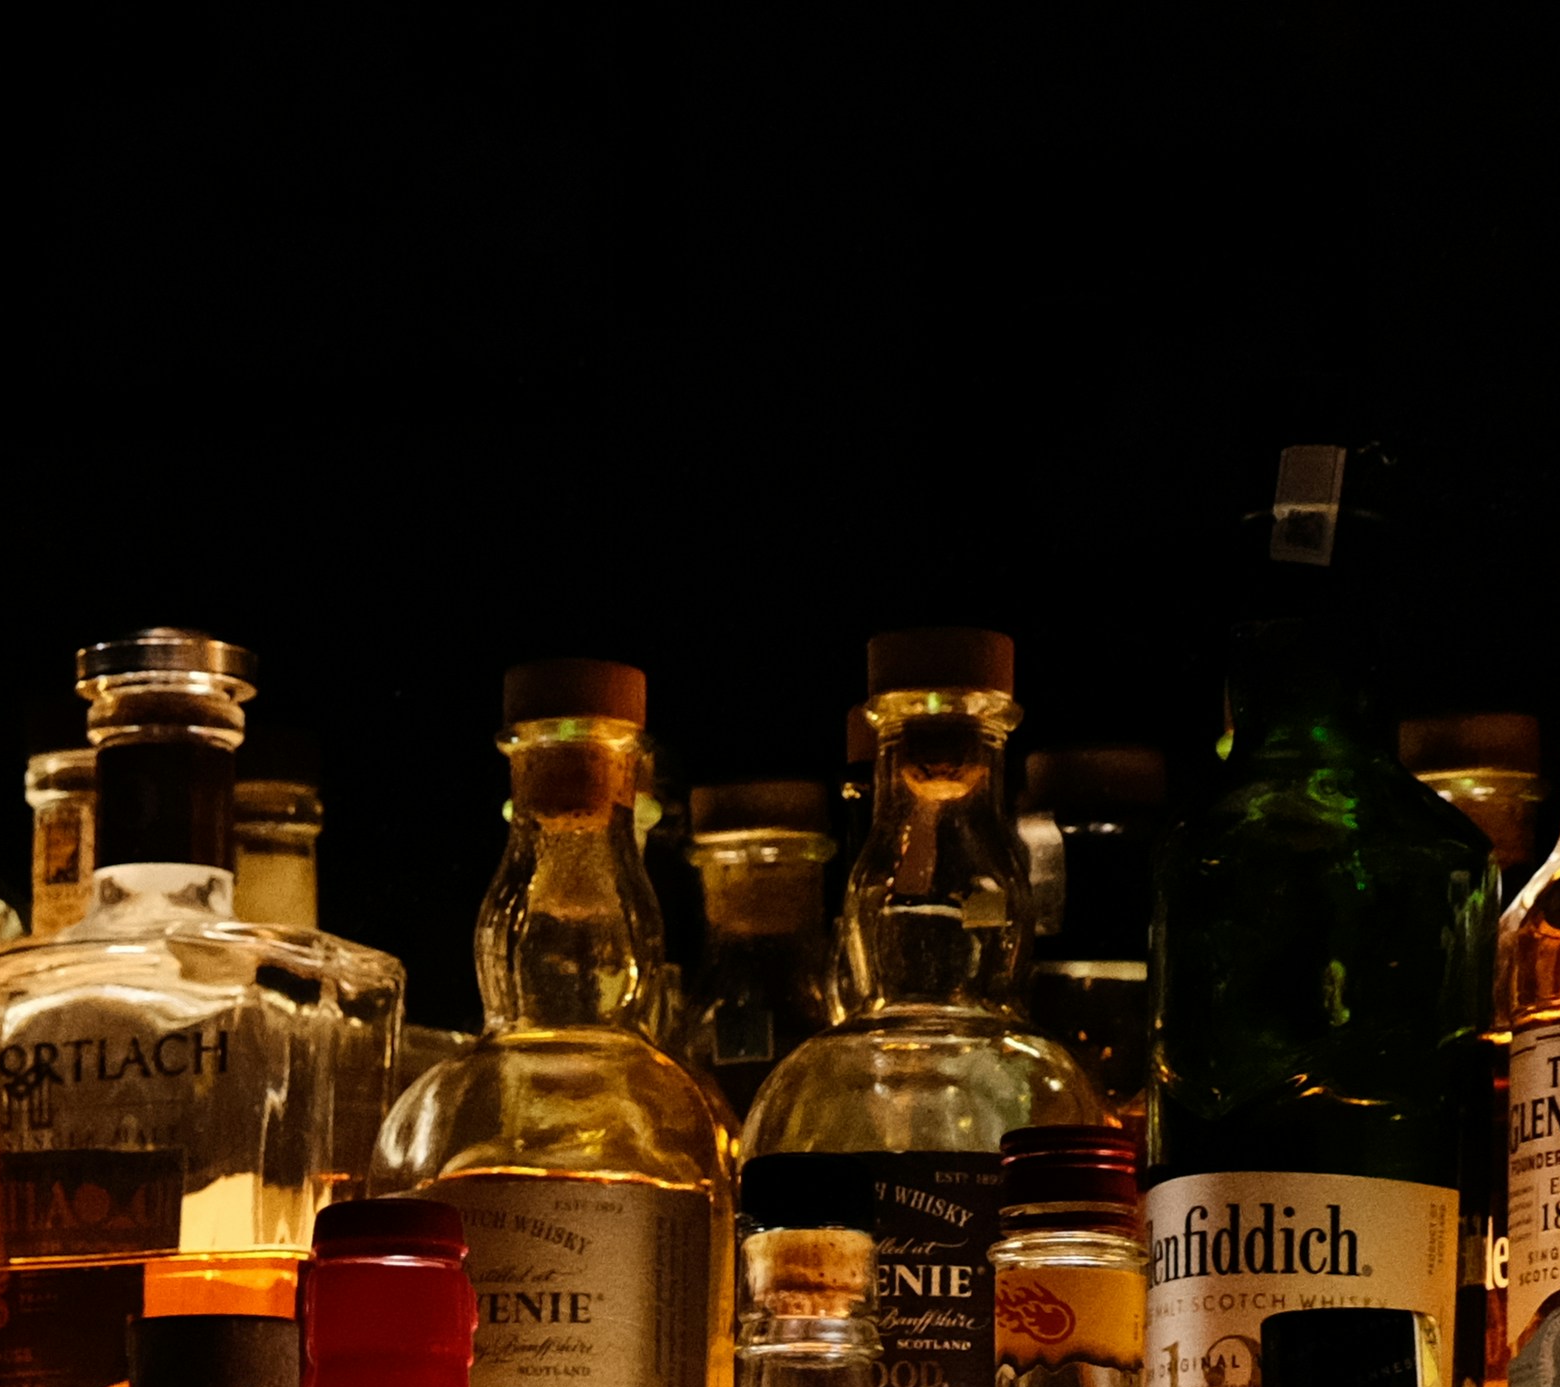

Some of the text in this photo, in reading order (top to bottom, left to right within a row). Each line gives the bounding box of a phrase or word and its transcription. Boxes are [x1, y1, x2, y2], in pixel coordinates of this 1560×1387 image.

[895, 1185, 974, 1227] WHISKY
[515, 1214, 592, 1254] WHISKY
[478, 1292, 592, 1324] ENIE
[1192, 1293, 1286, 1312] SCOTCH
[880, 1306, 976, 1333] Banffshire
[897, 1339, 971, 1351] SCOTLAND
[518, 1366, 591, 1376] SCOTLAND
